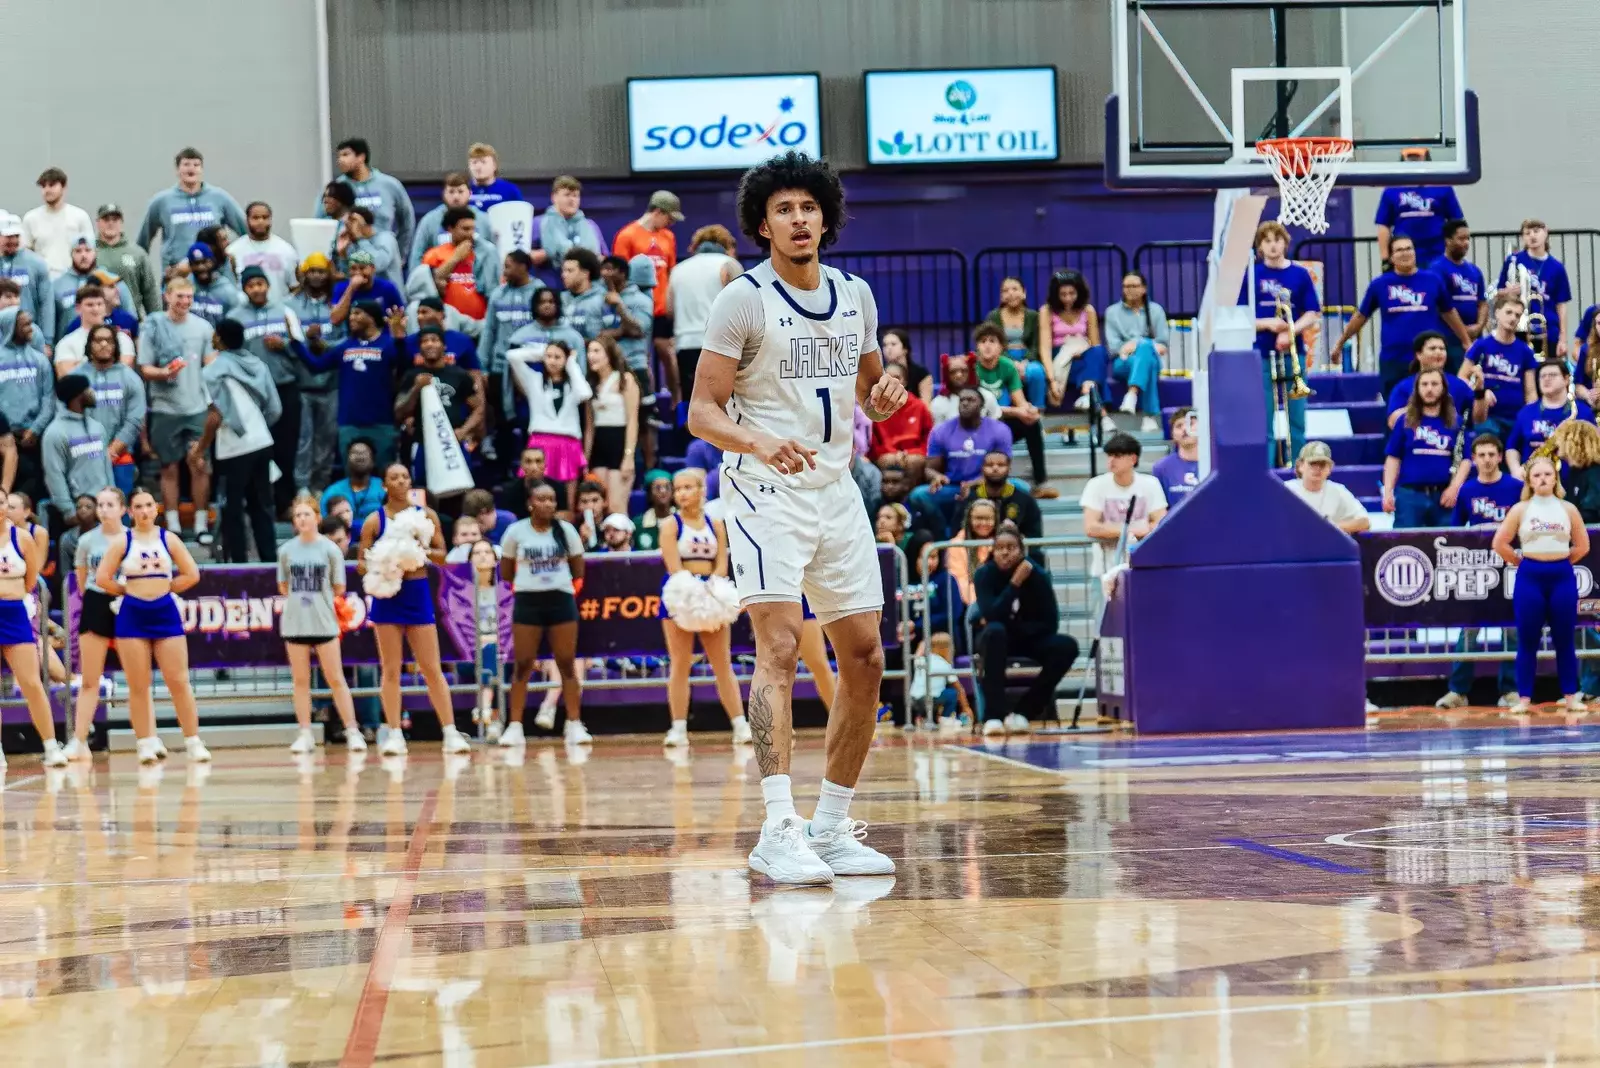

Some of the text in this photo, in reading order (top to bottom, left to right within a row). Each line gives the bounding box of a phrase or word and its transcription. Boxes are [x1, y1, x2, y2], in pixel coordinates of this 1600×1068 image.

[643, 114, 807, 151] sodexo
[915, 130, 1048, 153] LOTT OIL
[1388, 284, 1426, 306] NSU
[779, 333, 859, 380] JACKS
[1487, 354, 1519, 377] NSU
[815, 387, 832, 444] 1
[1415, 426, 1451, 450] NSU
[1532, 420, 1557, 437] NS
[1472, 497, 1509, 521] NSU
[1434, 567, 1500, 600] PEP
[579, 595, 661, 621] #FOR
